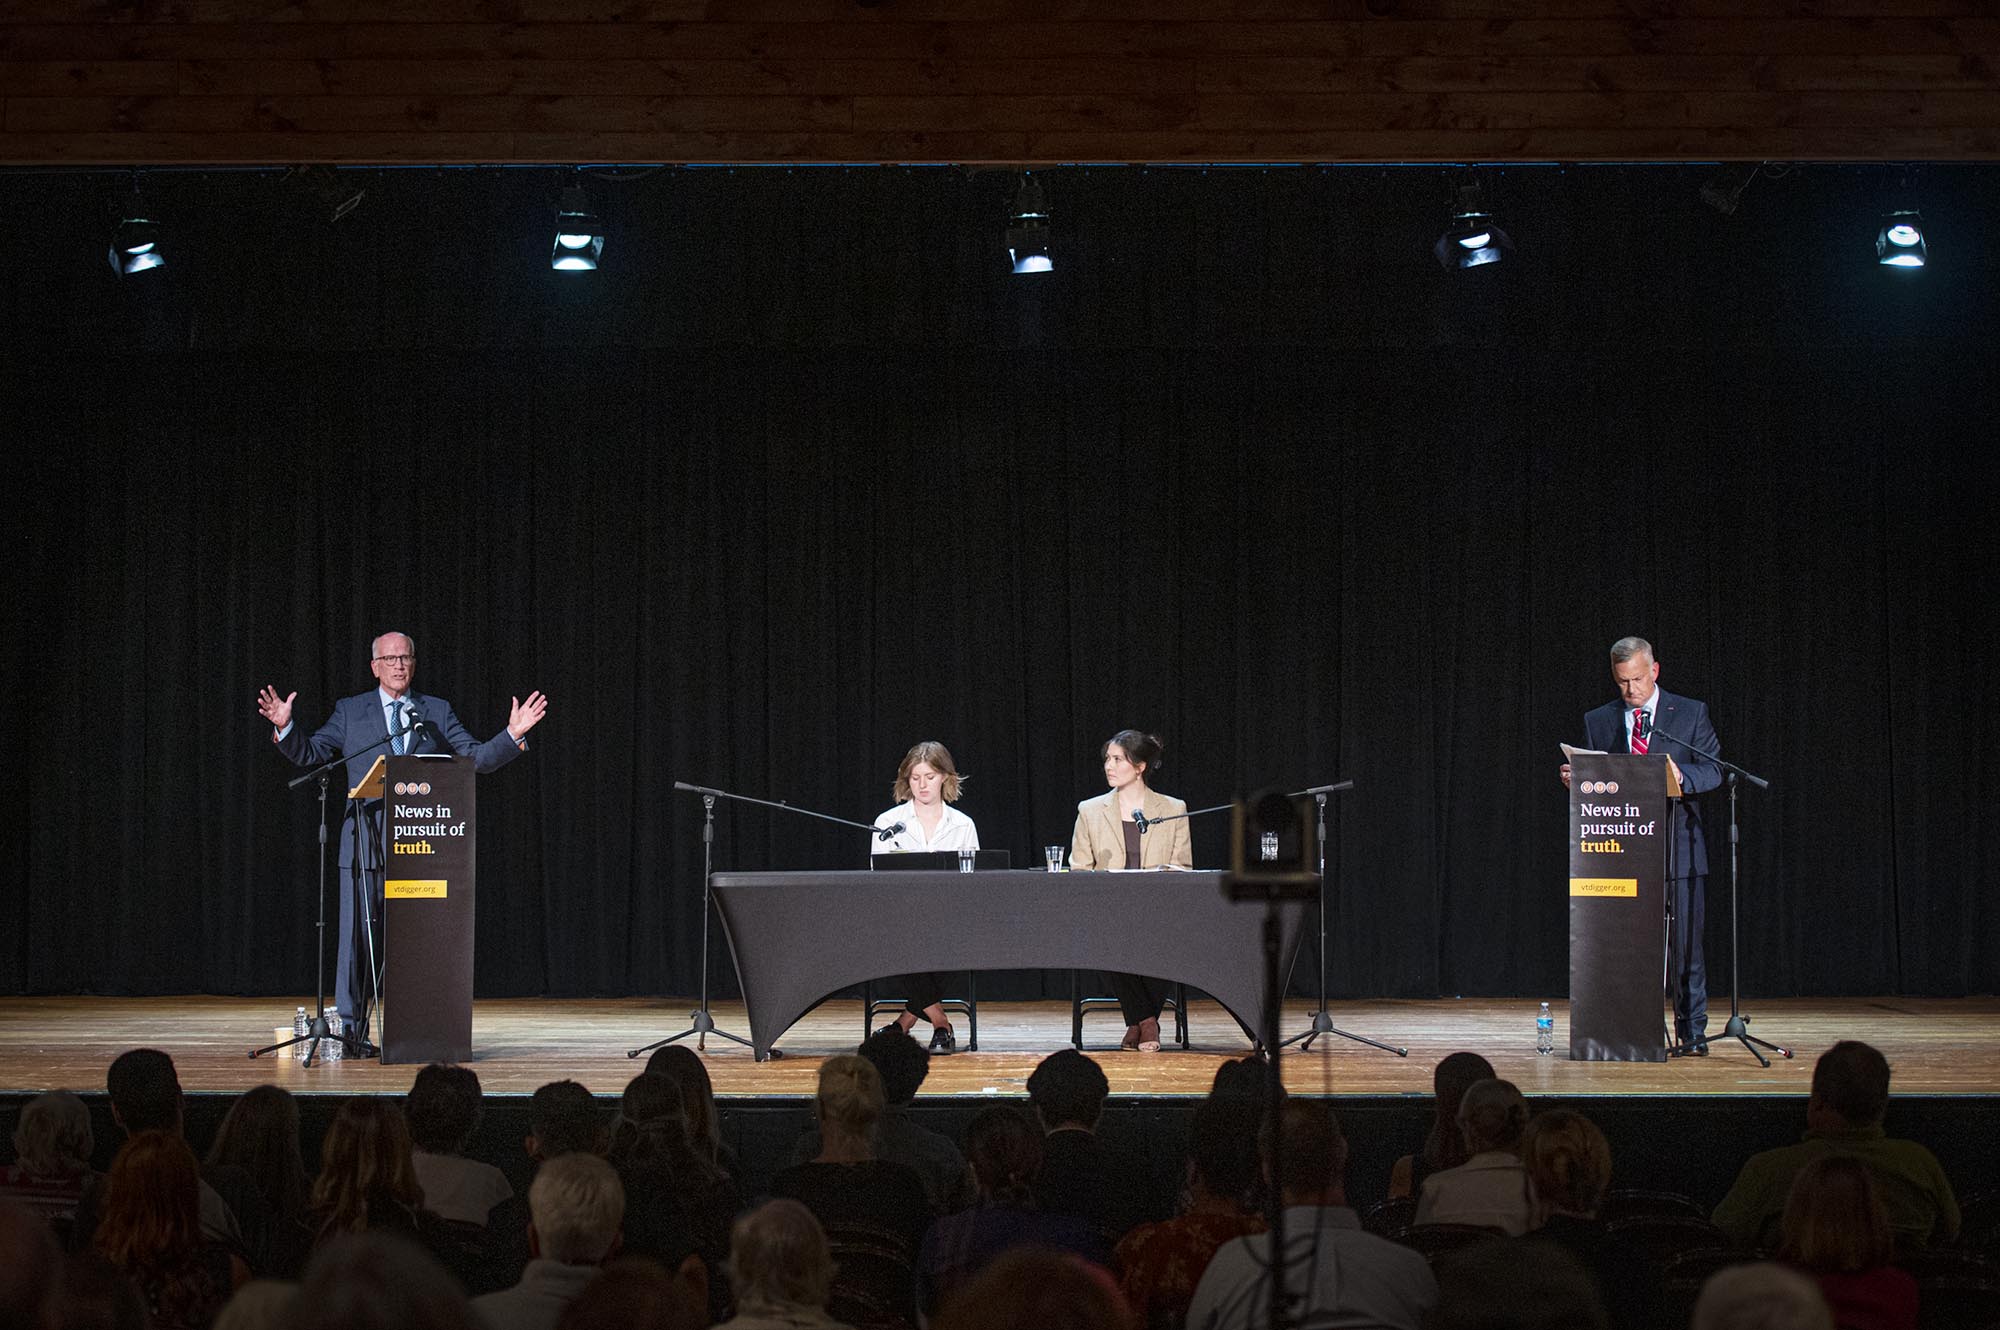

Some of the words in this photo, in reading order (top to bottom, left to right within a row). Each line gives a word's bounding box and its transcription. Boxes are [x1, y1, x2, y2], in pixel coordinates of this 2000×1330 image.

[394, 805, 433, 818] News
[436, 804, 451, 818] in
[1580, 803, 1621, 817] News
[1625, 803, 1640, 817] in
[394, 822, 446, 839] pursuit
[449, 822, 465, 836] of
[1580, 821, 1635, 838] pursuit
[1639, 821, 1655, 835] of
[393, 840, 435, 854] truth.
[1580, 839, 1624, 853] truth.
[393, 886, 436, 894] vtdigger.org
[1581, 884, 1626, 893] vtdigger.org
